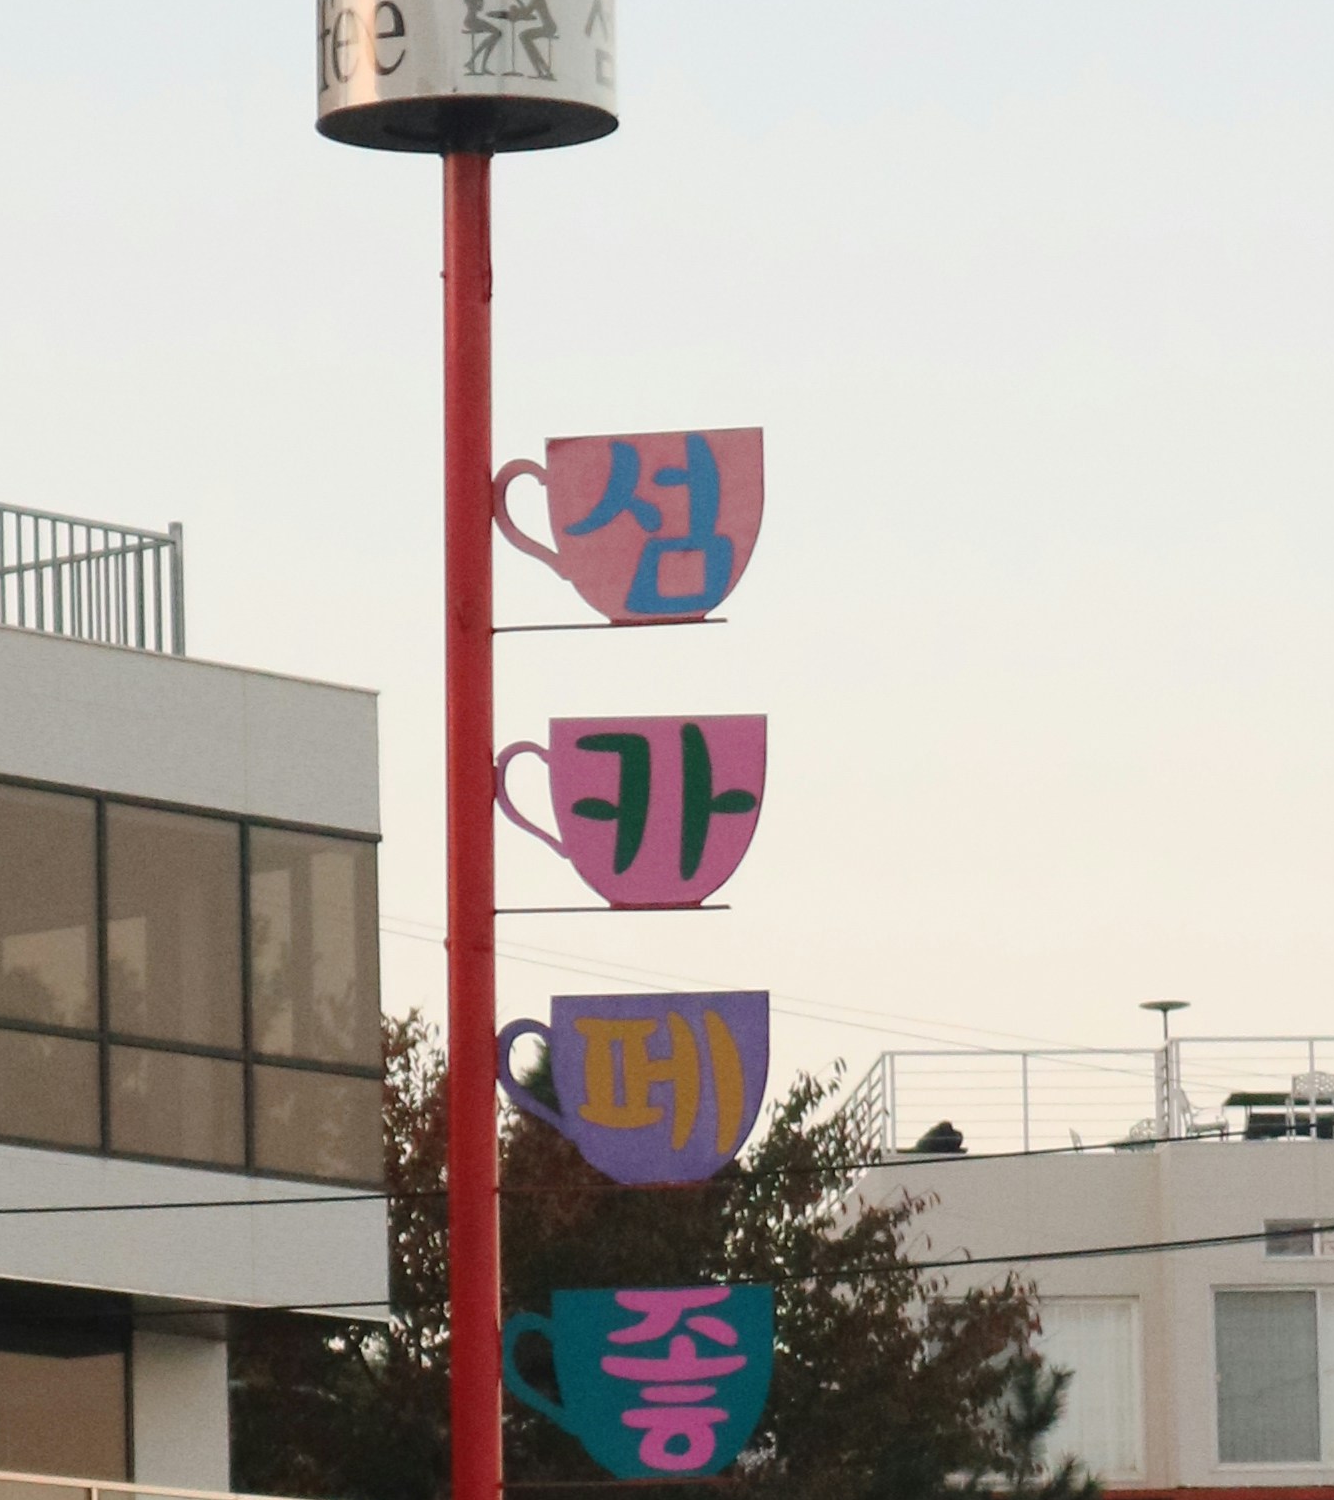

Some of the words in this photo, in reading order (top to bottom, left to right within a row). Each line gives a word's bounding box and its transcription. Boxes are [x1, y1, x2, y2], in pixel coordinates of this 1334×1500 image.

[565, 433, 733, 614] 섬
[572, 722, 757, 881] 카
[574, 1009, 745, 1155] 페
[600, 1286, 748, 1470] 좋
